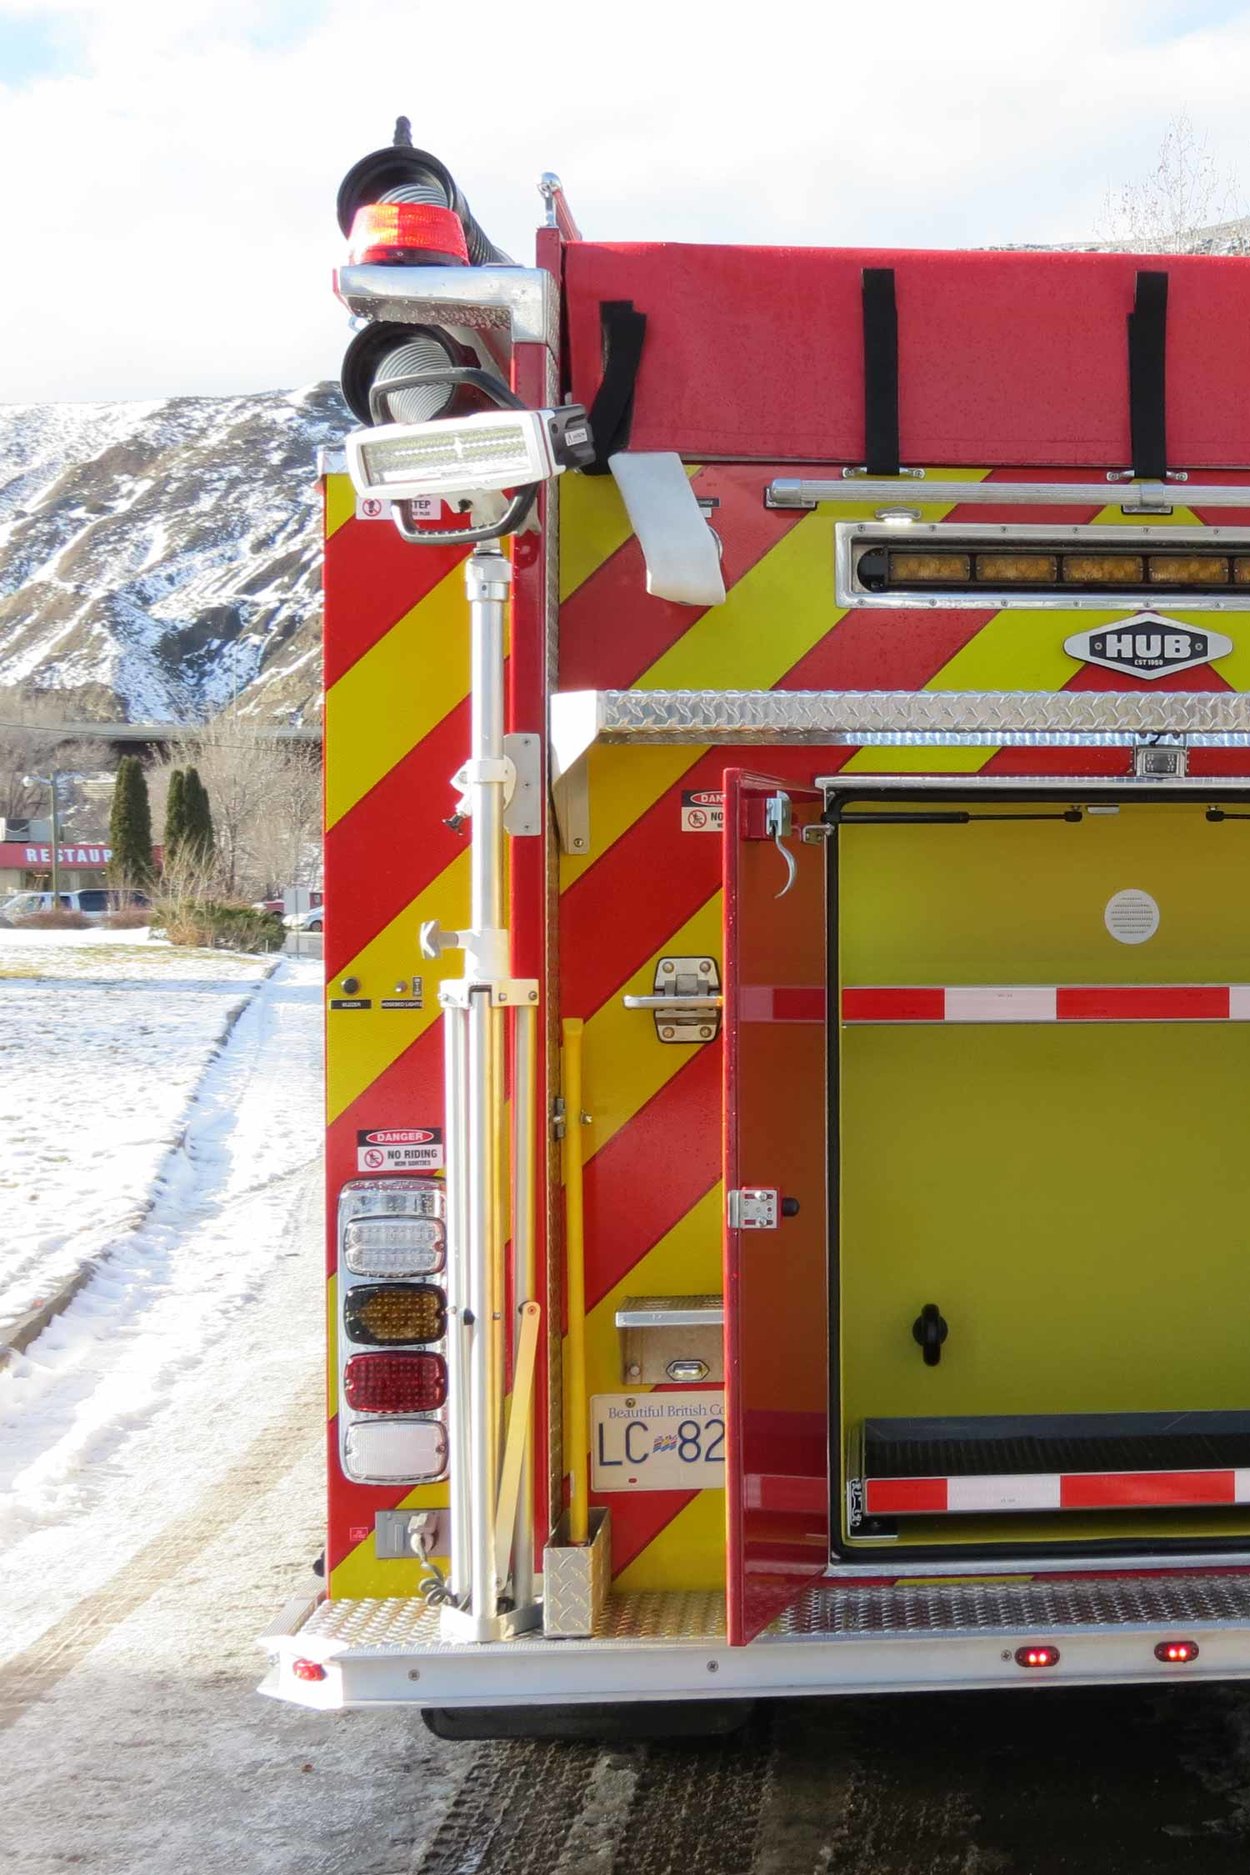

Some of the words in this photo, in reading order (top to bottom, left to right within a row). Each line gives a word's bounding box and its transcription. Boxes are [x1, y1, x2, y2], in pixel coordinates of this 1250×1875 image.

[411, 500, 431, 509] TEP
[1105, 634, 1191, 658] HUB
[377, 1132, 424, 1142] DANGER
[387, 1150, 401, 1159] NO
[404, 1149, 437, 1159] RIDING
[608, 1405, 664, 1419] Beautiful
[667, 1403, 707, 1418] British
[598, 1421, 649, 1466] LC
[678, 1419, 725, 1463] 82
